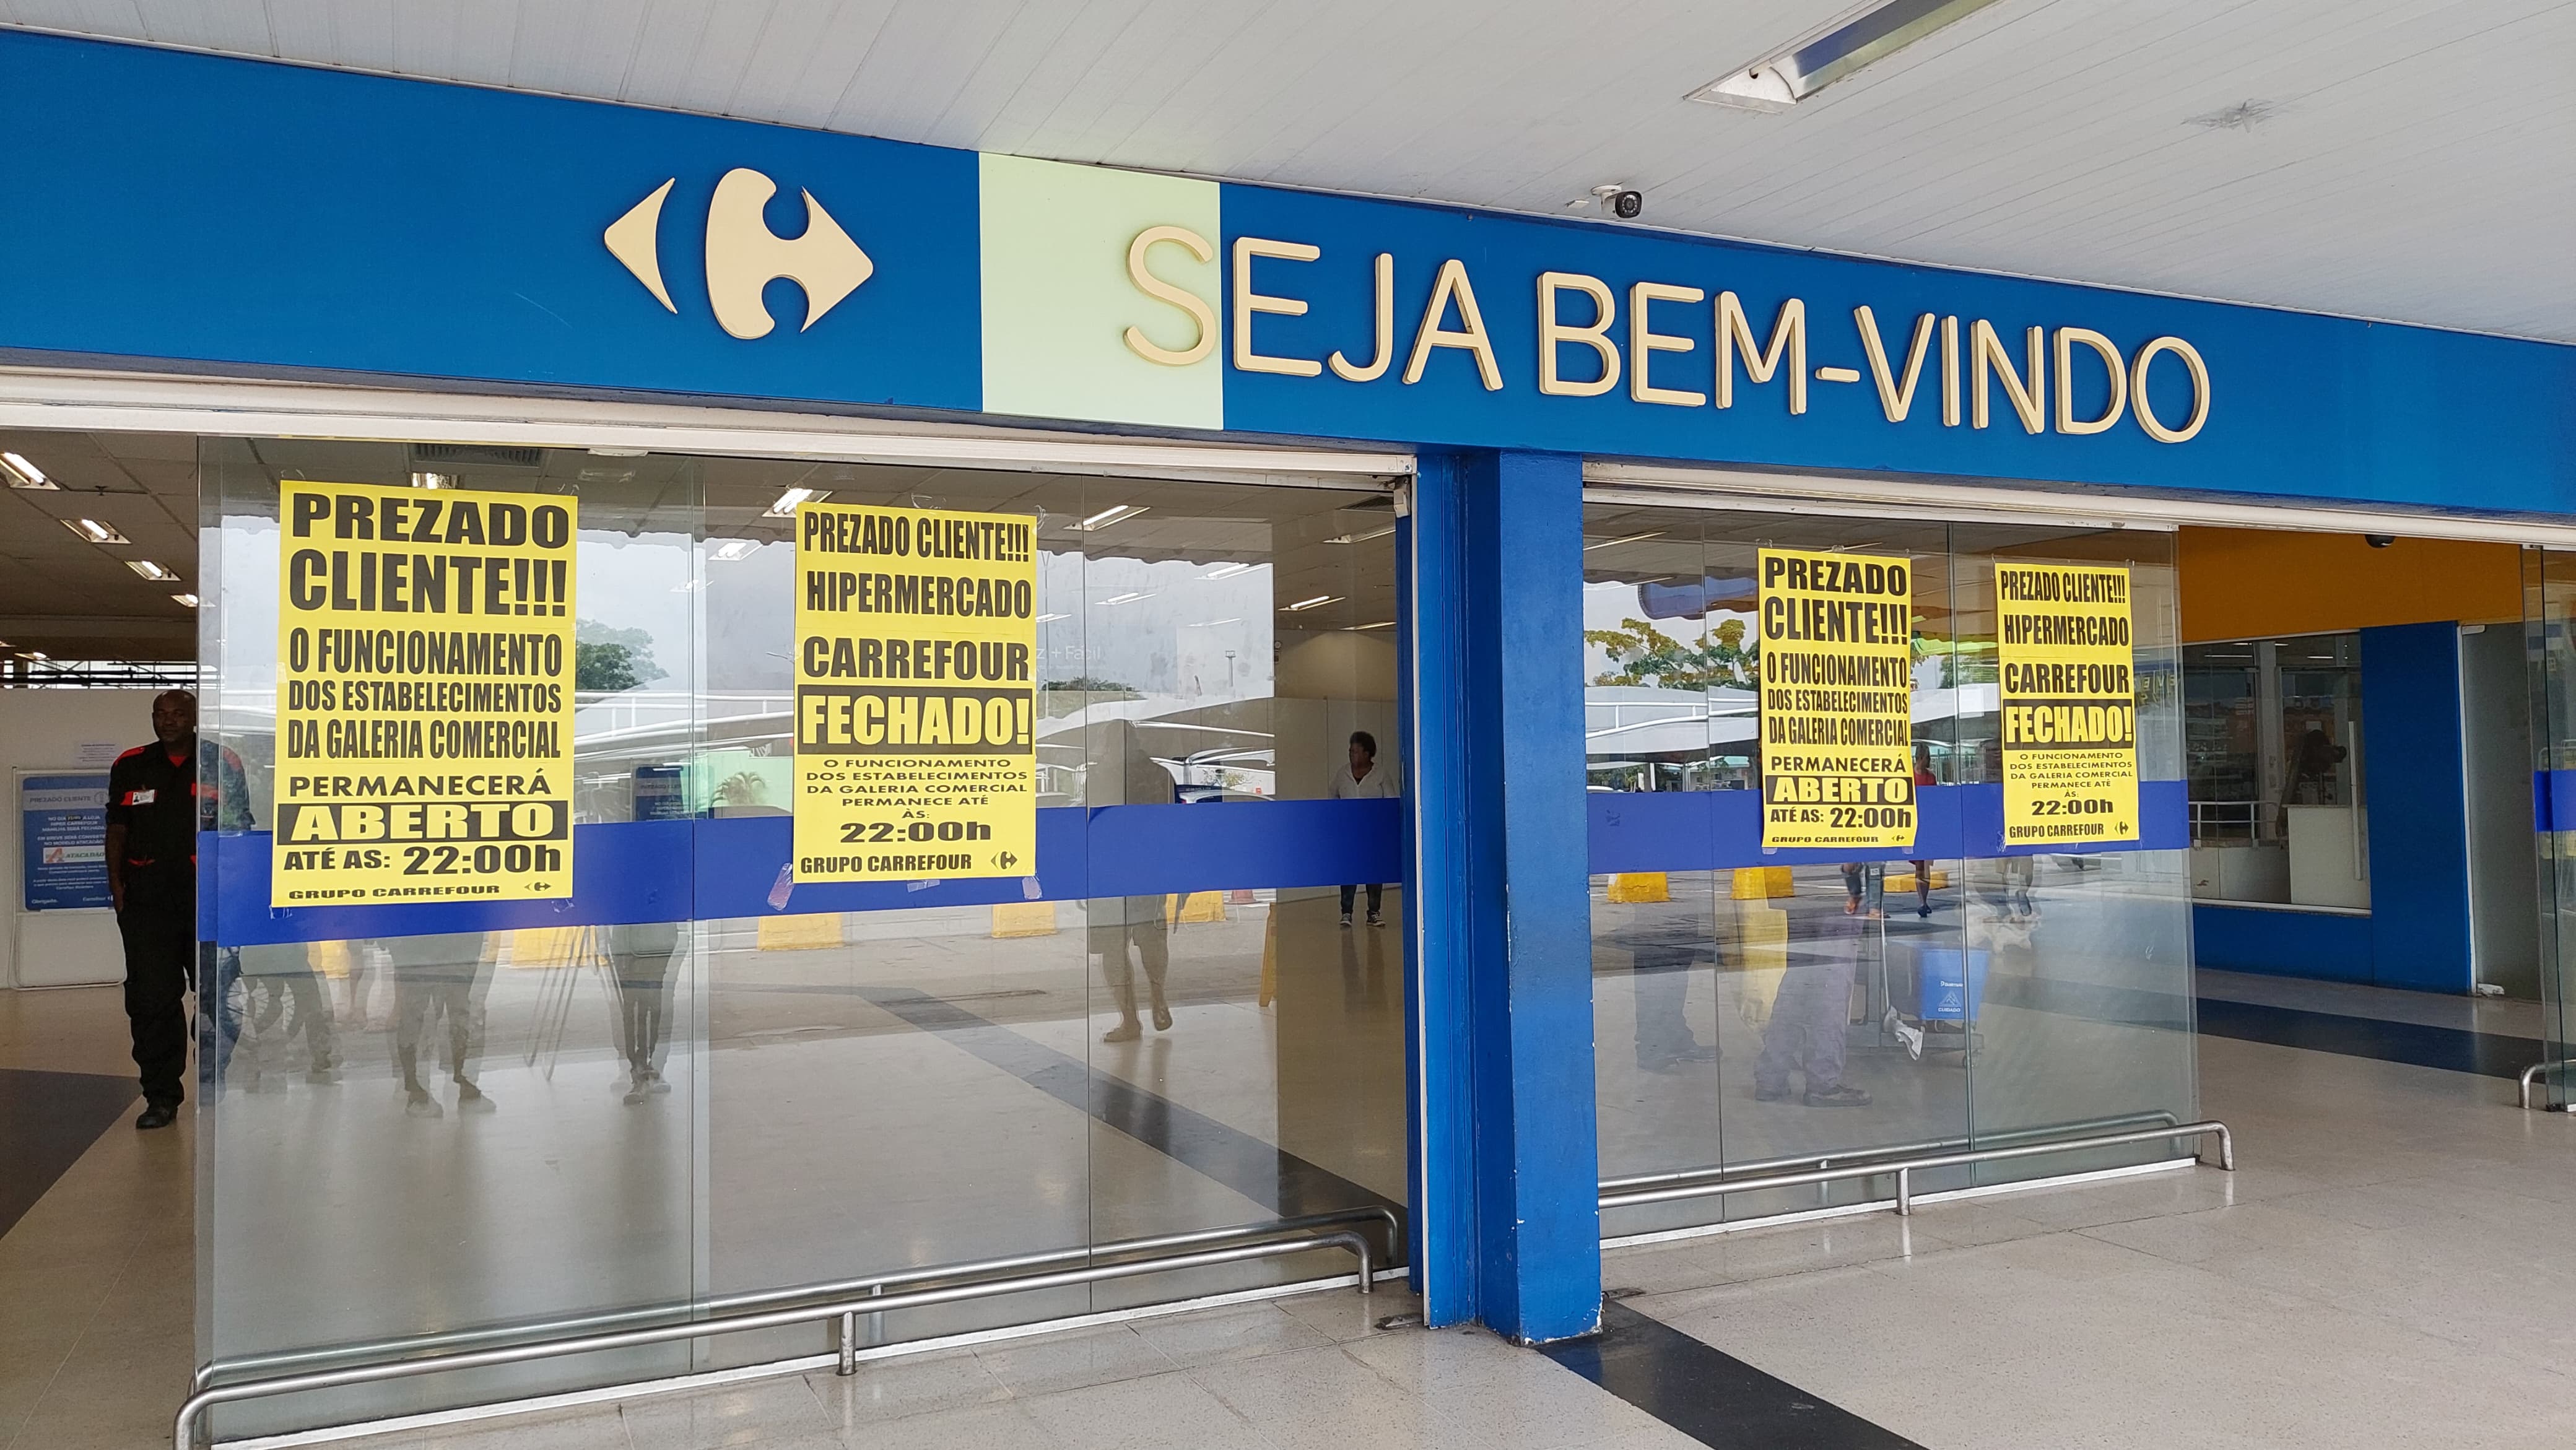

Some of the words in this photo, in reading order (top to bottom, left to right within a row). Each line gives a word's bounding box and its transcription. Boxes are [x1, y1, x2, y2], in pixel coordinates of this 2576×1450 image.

[1123, 224, 1505, 393] SEJA
[1536, 271, 2211, 444] BEM-VINDO
[293, 493, 568, 549] PREZADO
[804, 512, 908, 555] PREZADO
[917, 518, 1029, 562] CLIENTE!!!
[290, 549, 567, 617] CLIENTE!!!
[1765, 557, 1907, 596] PREZADO
[2001, 571, 2060, 602] PREZADO
[2063, 573, 2126, 604] CLIENTE!!!
[807, 570, 1031, 619] HIPERMERCADO
[1764, 596, 1907, 644] CLIENTE!!!
[2004, 614, 2129, 647] HIPERMERCADO
[290, 627, 308, 672] O
[318, 628, 562, 676] FUNCIONAMENTO
[804, 636, 1029, 680] CARREFOUR
[1767, 653, 1777, 685] O
[1780, 654, 1907, 688] FUNCIONAMENTO
[2006, 663, 2129, 694] CARREFOUR
[289, 680, 336, 711] DOS
[342, 681, 561, 713] ESTABELECIMENTOS
[1768, 688, 1792, 710] DOS
[1796, 690, 1907, 714] ESTABELECIMENTOS
[803, 695, 1030, 746] FECHADO!
[1769, 716, 1785, 744] DA
[1789, 717, 1837, 745] GALERIA
[1840, 718, 1908, 746] COMERCIAL
[2006, 705, 2133, 743] FECHADO!
[288, 719, 320, 758] DA
[326, 719, 423, 758] GALERIA
[430, 719, 560, 758] COMERCIAL
[846, 759, 1011, 768] FUNCIONAMENTO
[853, 772, 1027, 780] ESTABELECIMENTOS
[1772, 753, 1906, 772] PERMANECERÁ
[290, 767, 551, 797] PERMANECERÁ
[840, 785, 918, 793] GALERIA
[925, 784, 1027, 792] COMERCIAL
[1773, 777, 1908, 802] ABERTO
[843, 797, 952, 806] PERMANECE
[959, 795, 988, 805] ATÉ
[902, 809, 929, 818] ÀS:
[2032, 799, 2113, 815] 22:00h
[290, 802, 553, 841] ABERTO
[840, 822, 991, 843] 22:00h
[1771, 807, 1796, 822] ATÉ
[1801, 809, 1824, 822] AS:
[1830, 807, 1911, 828] 22:00h
[2009, 825, 2044, 838] GRUPO
[2047, 823, 2104, 836] CARREFOUR
[284, 848, 334, 870] ATÉ
[343, 849, 390, 869] AS:
[403, 844, 560, 875] 22:00h
[801, 856, 862, 873] GRUPO
[868, 854, 972, 871] CARREFOUR
[289, 888, 365, 899] GRUPO
[373, 885, 500, 897] CARREFOUR
